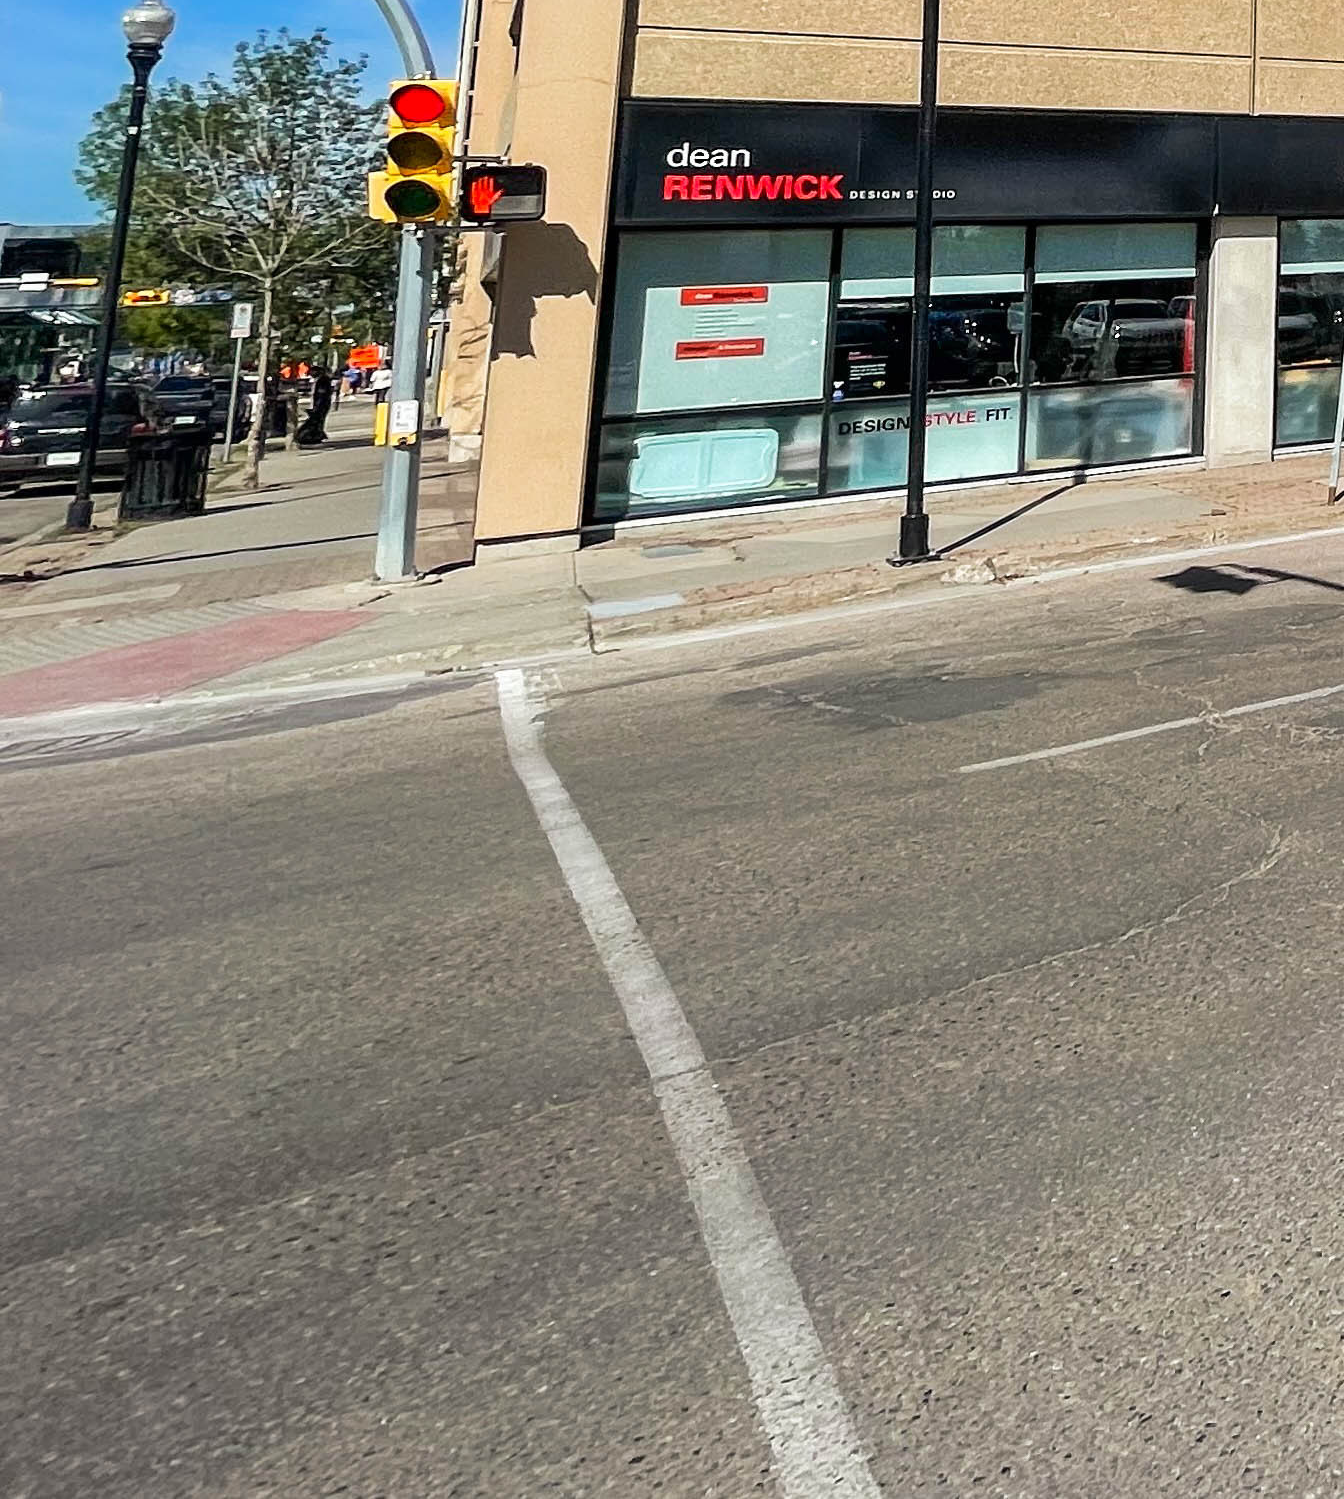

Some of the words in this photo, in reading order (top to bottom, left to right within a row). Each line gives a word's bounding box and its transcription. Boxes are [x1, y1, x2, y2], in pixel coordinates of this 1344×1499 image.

[666, 142, 750, 168] dean
[663, 174, 844, 200] RENWICK
[849, 190, 901, 200] DESIGN
[906, 190, 956, 199] SDIO
